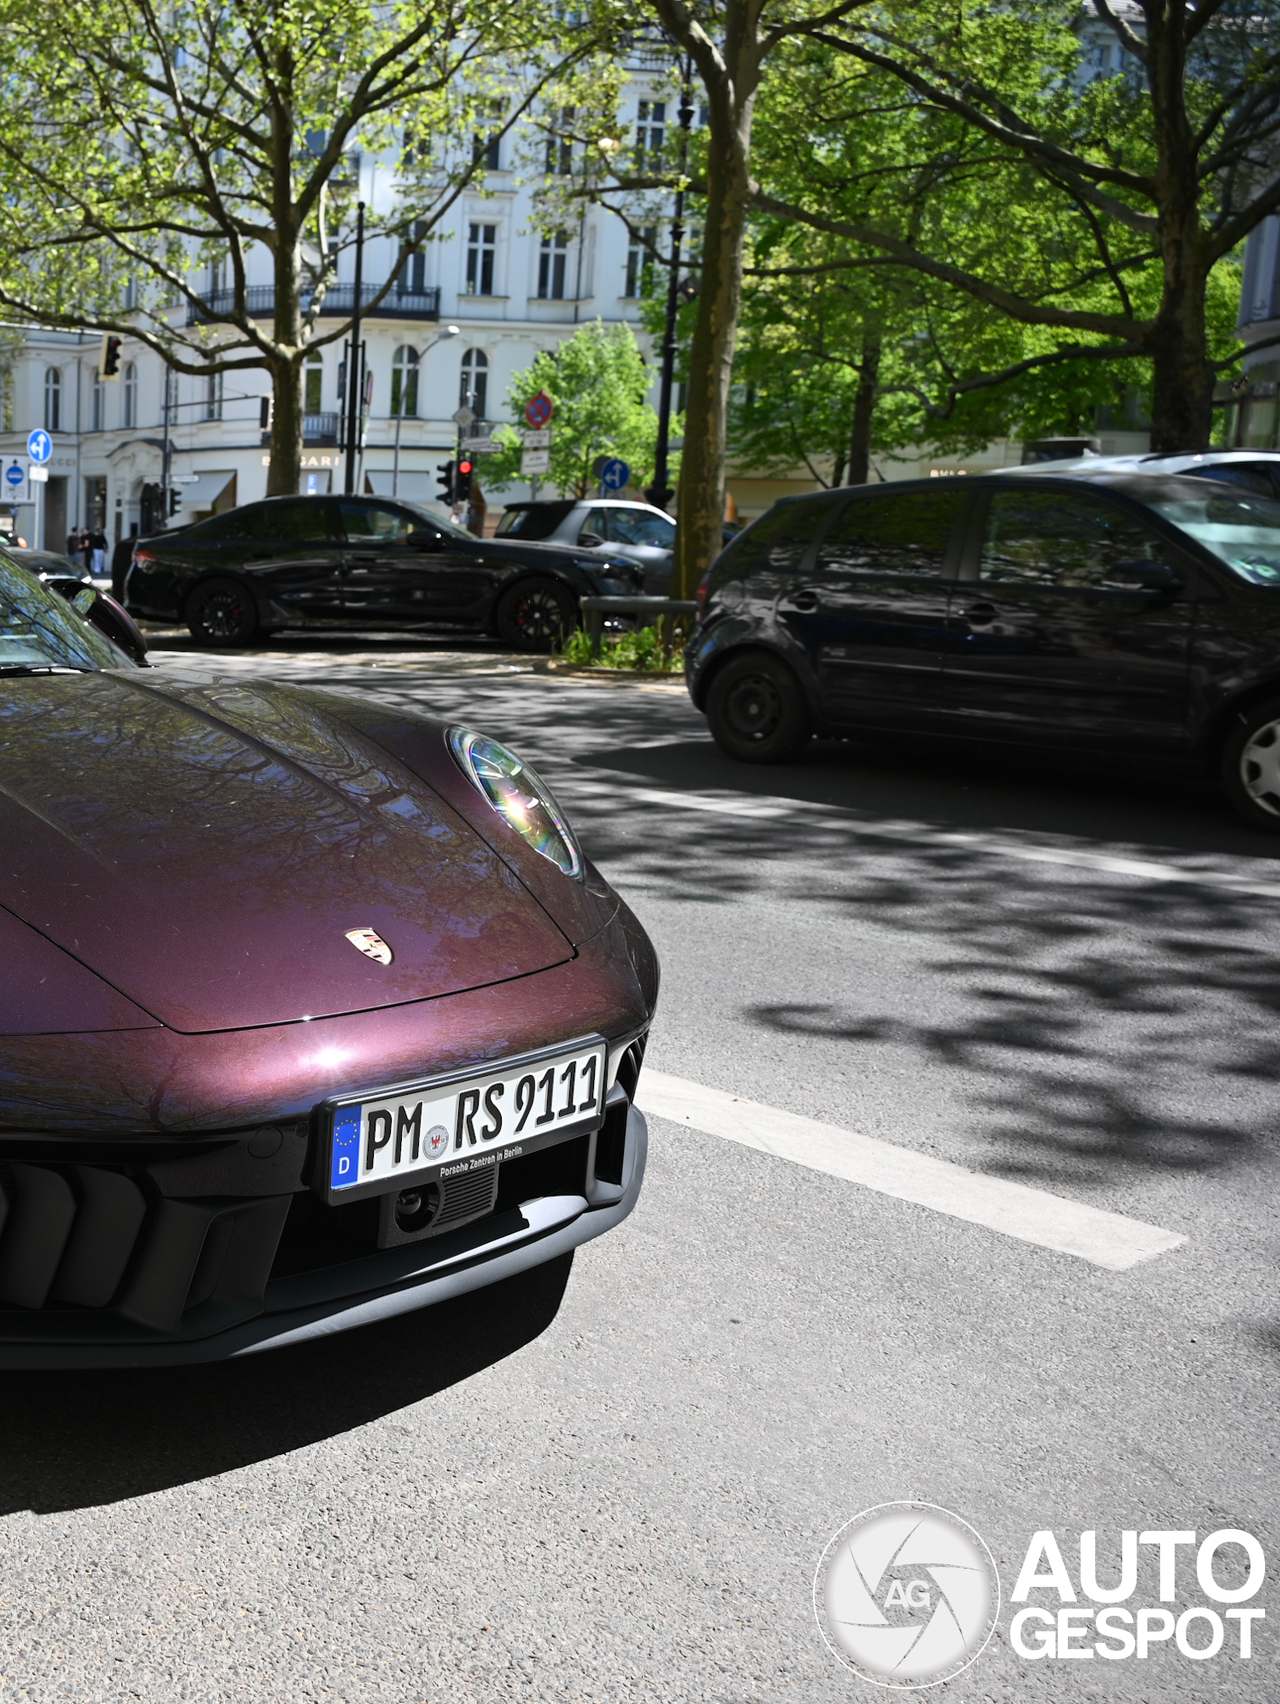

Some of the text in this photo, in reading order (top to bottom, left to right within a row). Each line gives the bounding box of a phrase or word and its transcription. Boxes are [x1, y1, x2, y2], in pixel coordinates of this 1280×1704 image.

[366, 1101, 424, 1170] PM
[455, 1082, 504, 1149] RS
[515, 1055, 598, 1132] 9111
[338, 1156, 350, 1175] D
[440, 1145, 523, 1177] Porsche Zentren in Berlin
